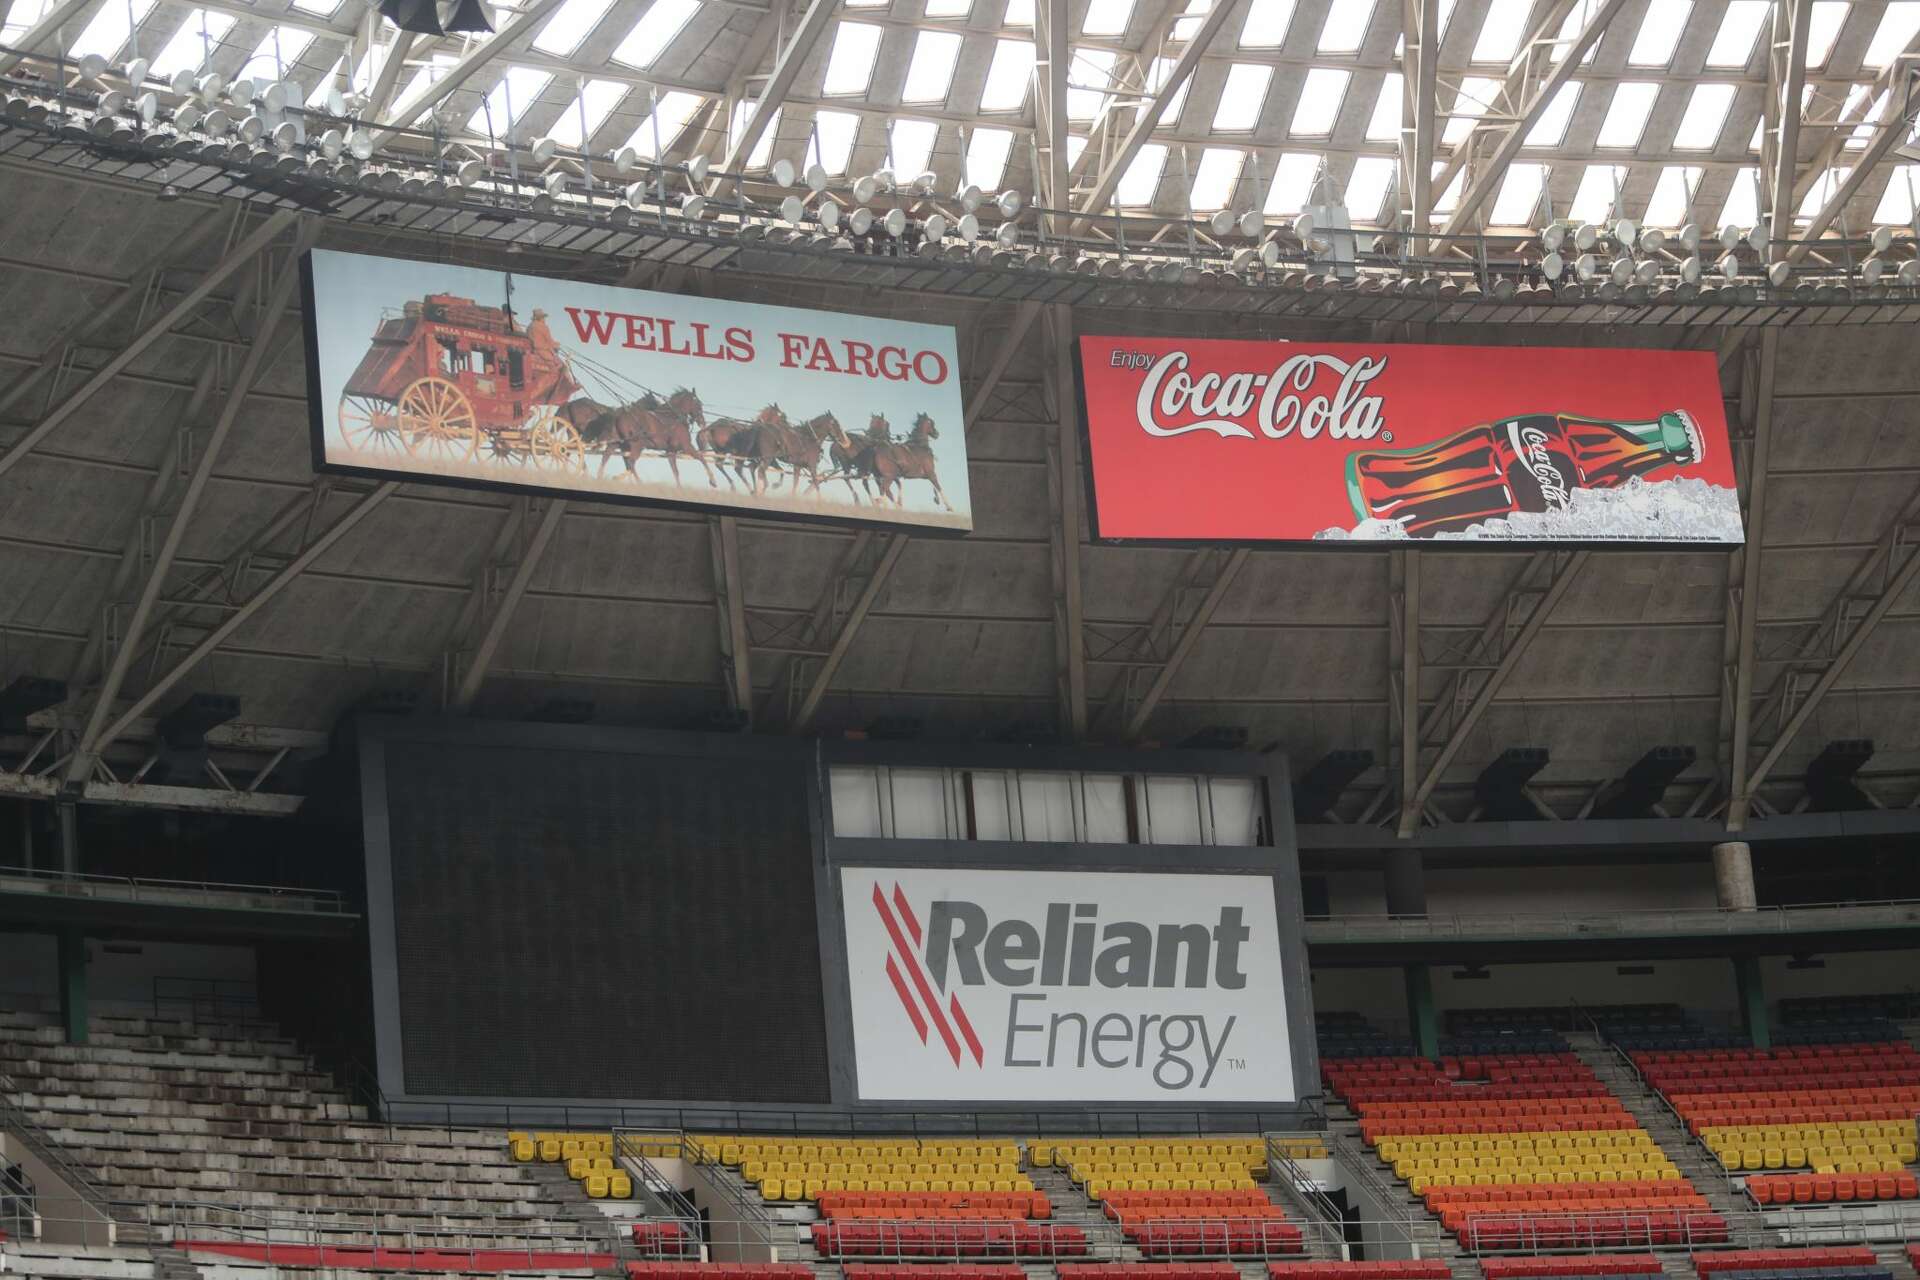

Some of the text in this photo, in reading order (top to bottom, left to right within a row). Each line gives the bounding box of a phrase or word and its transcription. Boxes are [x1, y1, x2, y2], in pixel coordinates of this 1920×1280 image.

[564, 307, 950, 386] WELLS FARGO
[1110, 350, 1156, 370] Enjoy
[1136, 351, 1388, 441] Coca-Cola
[925, 900, 1251, 997] Reliant
[1004, 993, 1237, 1090] Energy
